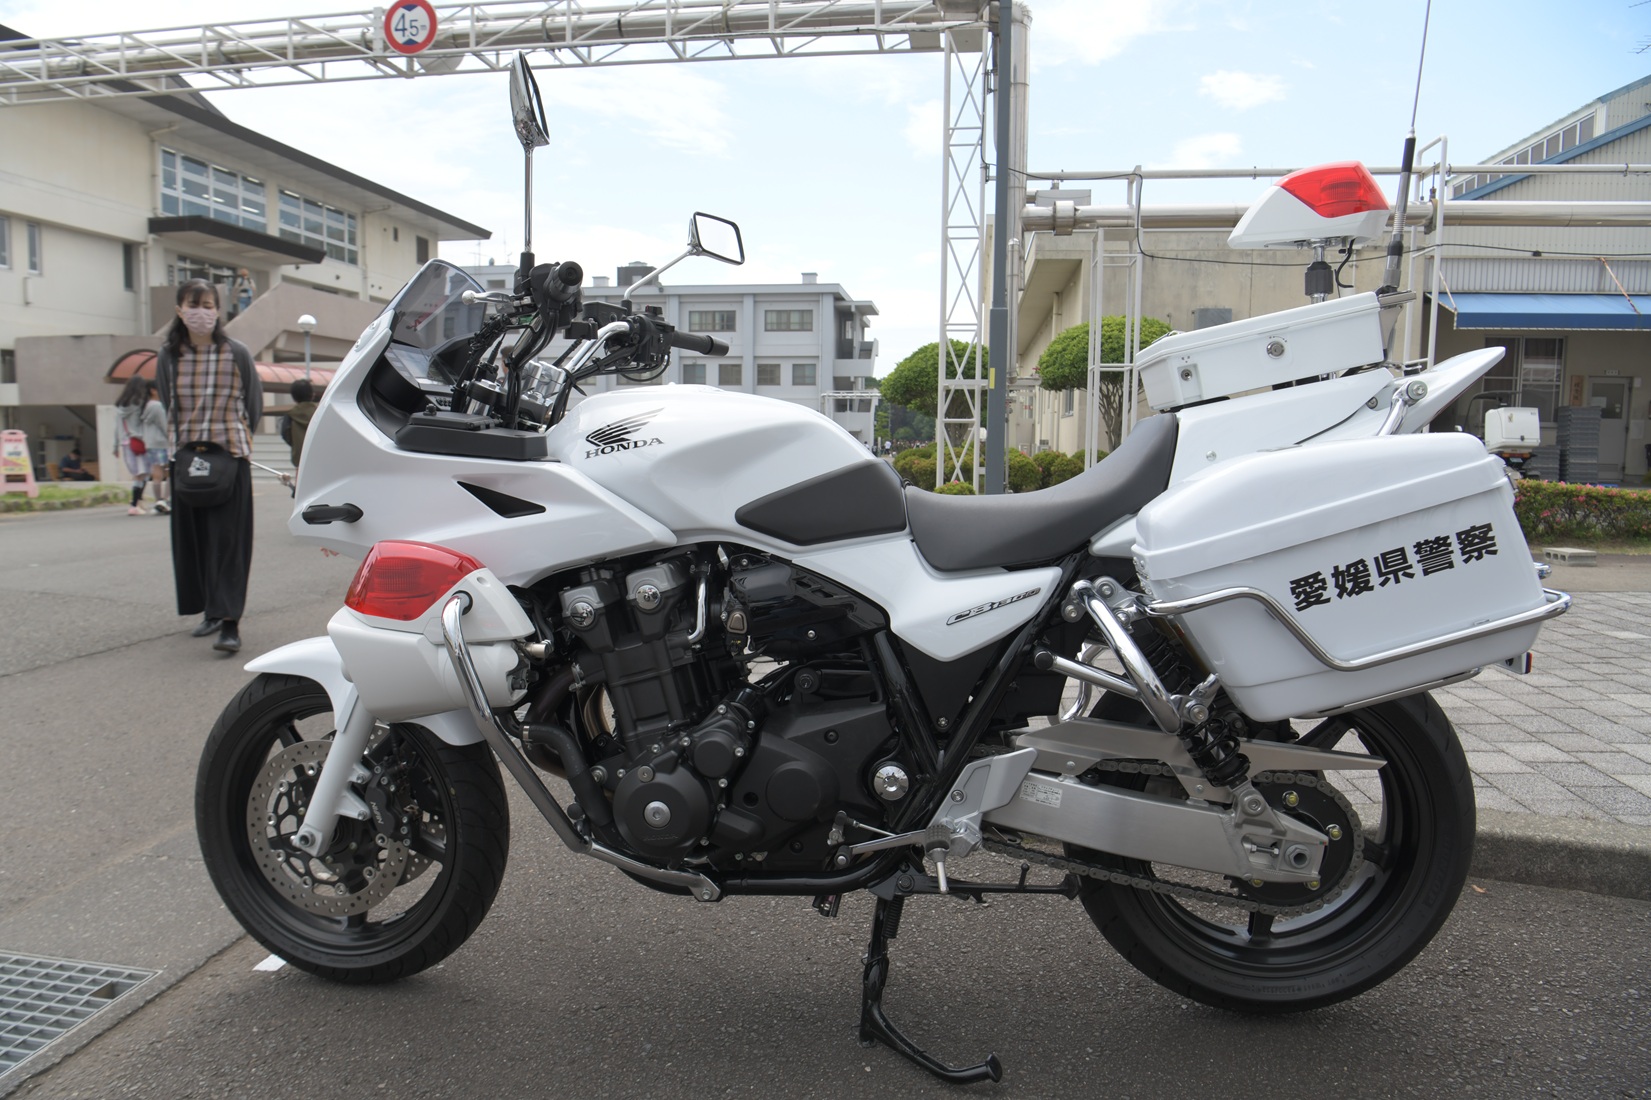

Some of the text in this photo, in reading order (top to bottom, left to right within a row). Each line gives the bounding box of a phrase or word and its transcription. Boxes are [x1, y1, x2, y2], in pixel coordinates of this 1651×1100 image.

[584, 437, 664, 460] HONDA
[1289, 522, 1499, 612] 愛媛県警察
